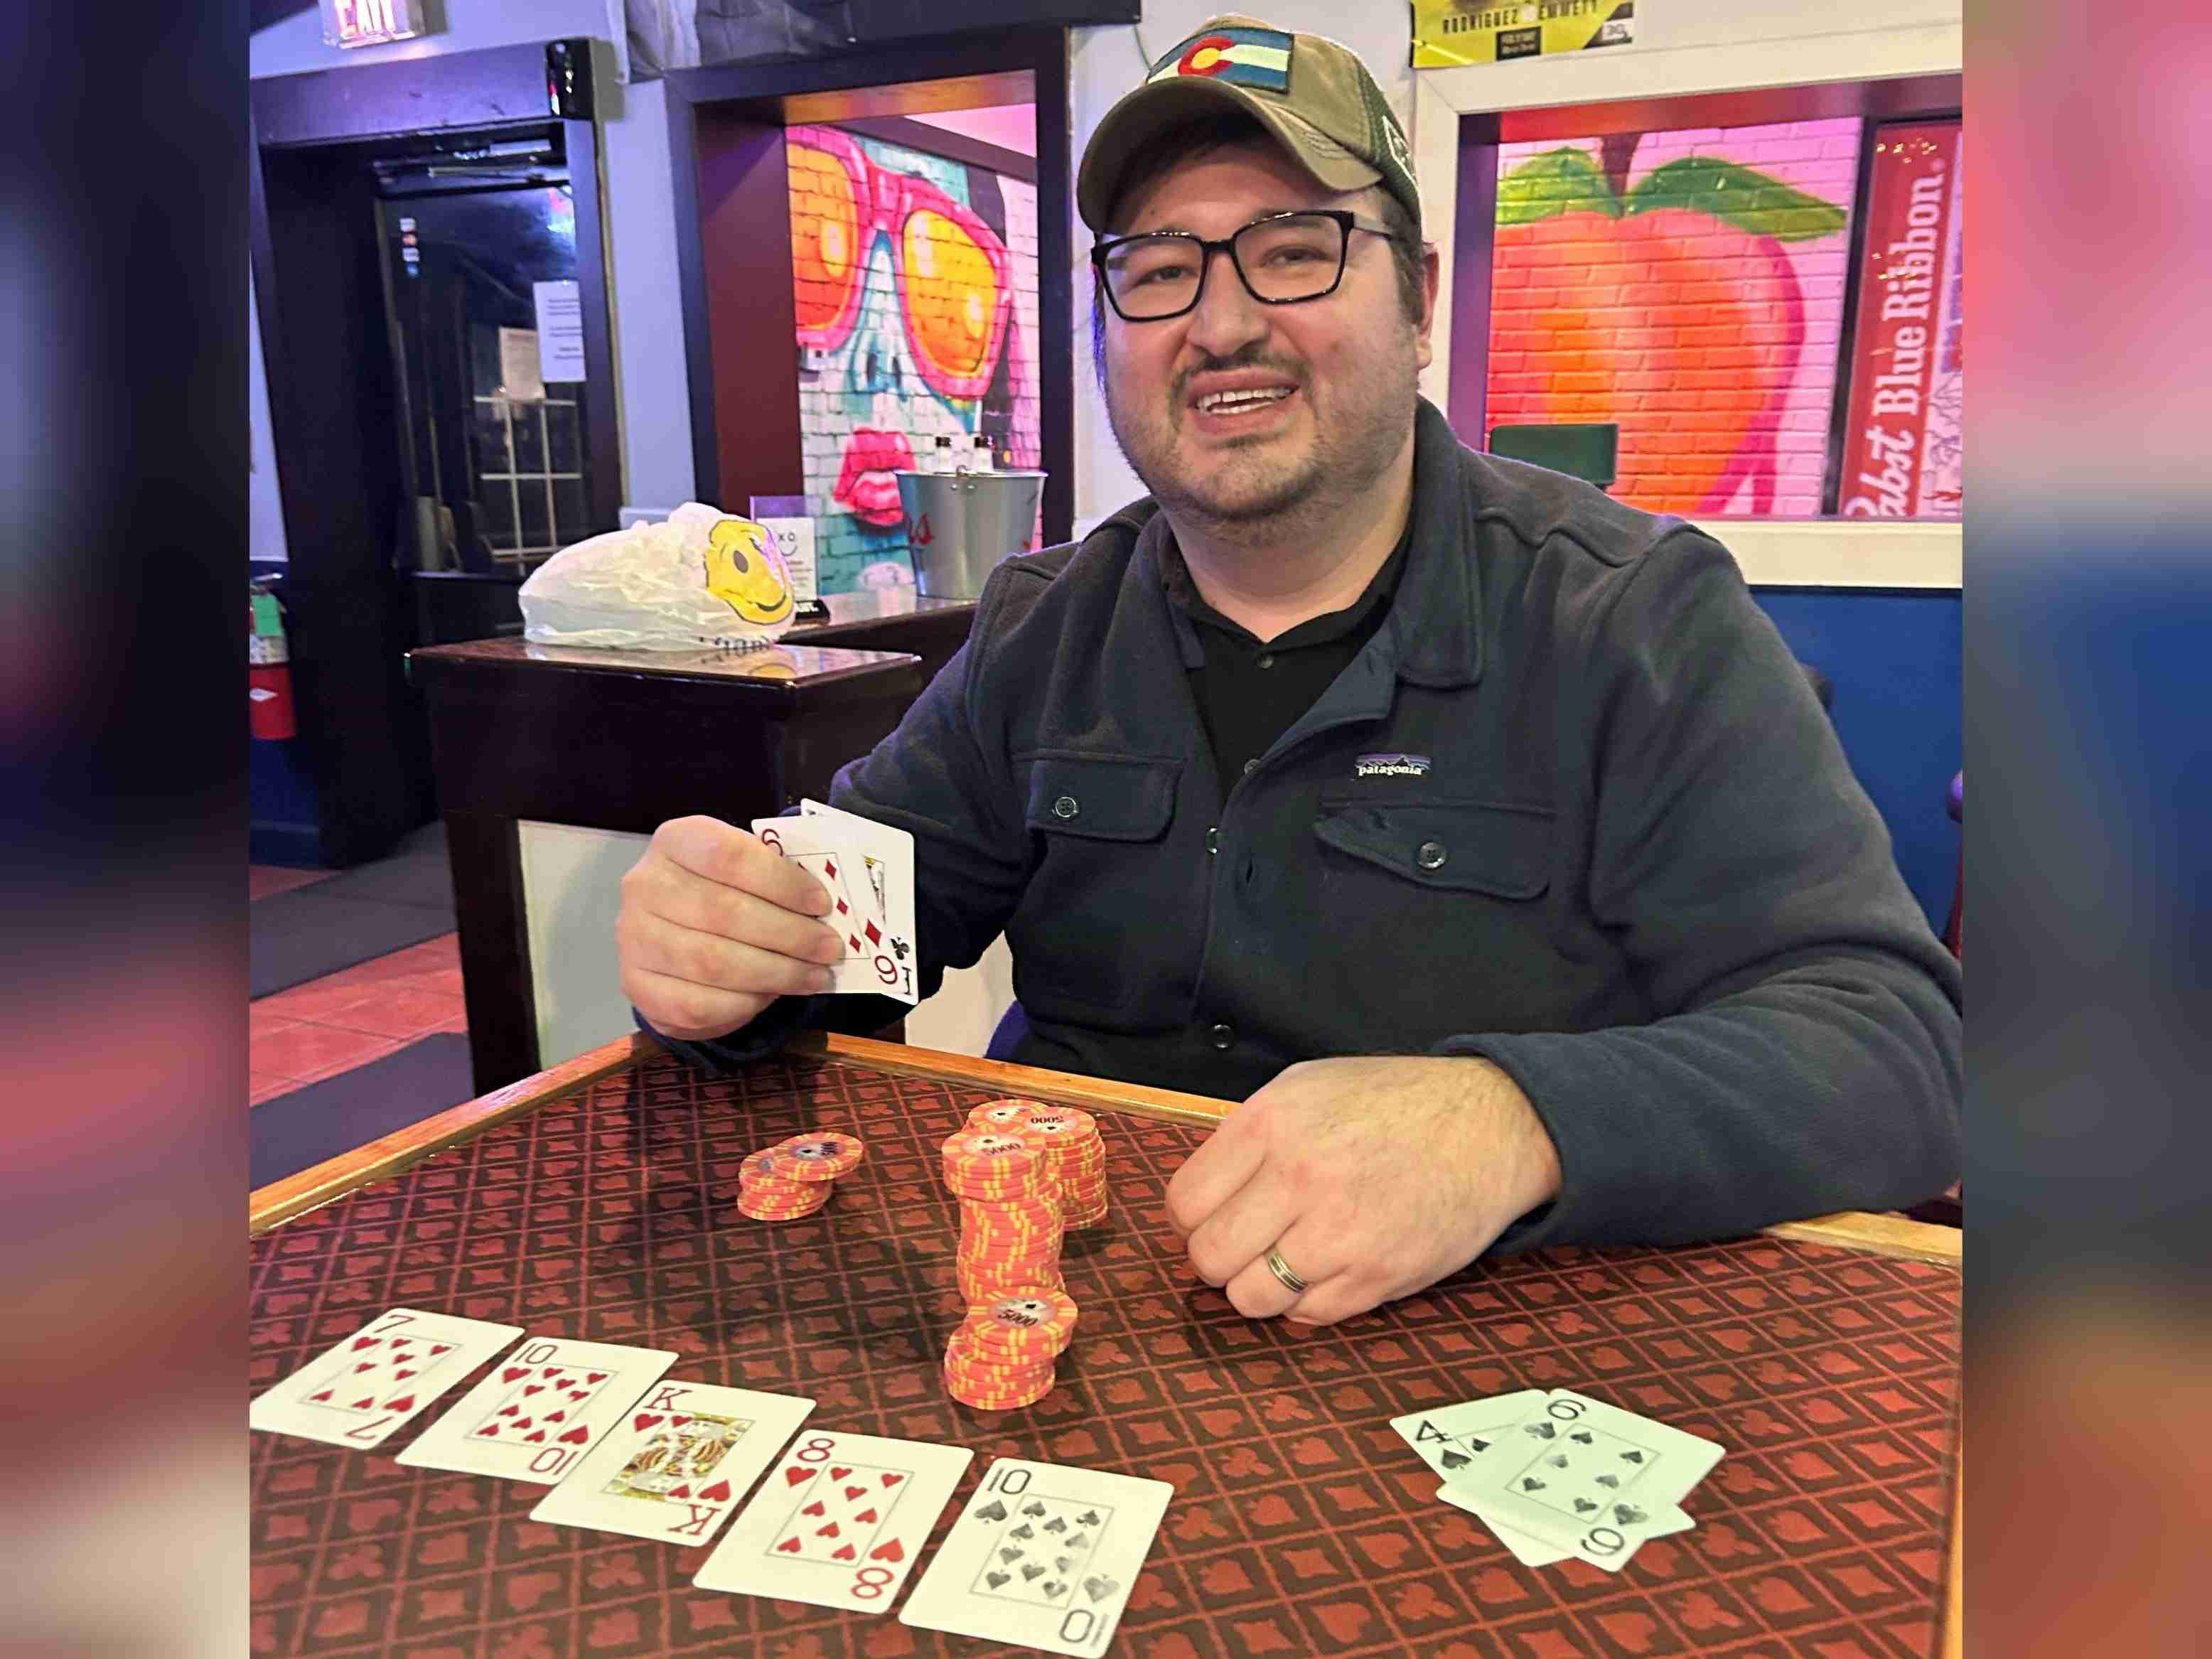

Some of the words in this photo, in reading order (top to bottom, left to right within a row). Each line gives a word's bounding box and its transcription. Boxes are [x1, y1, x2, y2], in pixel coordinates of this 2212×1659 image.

[1443, 9, 1519, 33] RODRIGUEZ
[1872, 326, 1927, 417] Blue
[1358, 765, 1422, 775] patagonia
[1031, 1115, 1065, 1124] 5000
[373, 1314, 416, 1333] 7
[997, 1309, 1038, 1326] 5000
[514, 1342, 558, 1365] 10
[643, 1387, 692, 1411] K
[1546, 1398, 1586, 1421] 6
[345, 1416, 394, 1440] 7
[1416, 1419, 1452, 1444] 4
[528, 1446, 578, 1476] 10
[796, 1438, 835, 1463] 8
[987, 1466, 1032, 1495] 10
[667, 1504, 722, 1535] K
[850, 1567, 894, 1599] 8
[1058, 1609, 1110, 1648] 10
